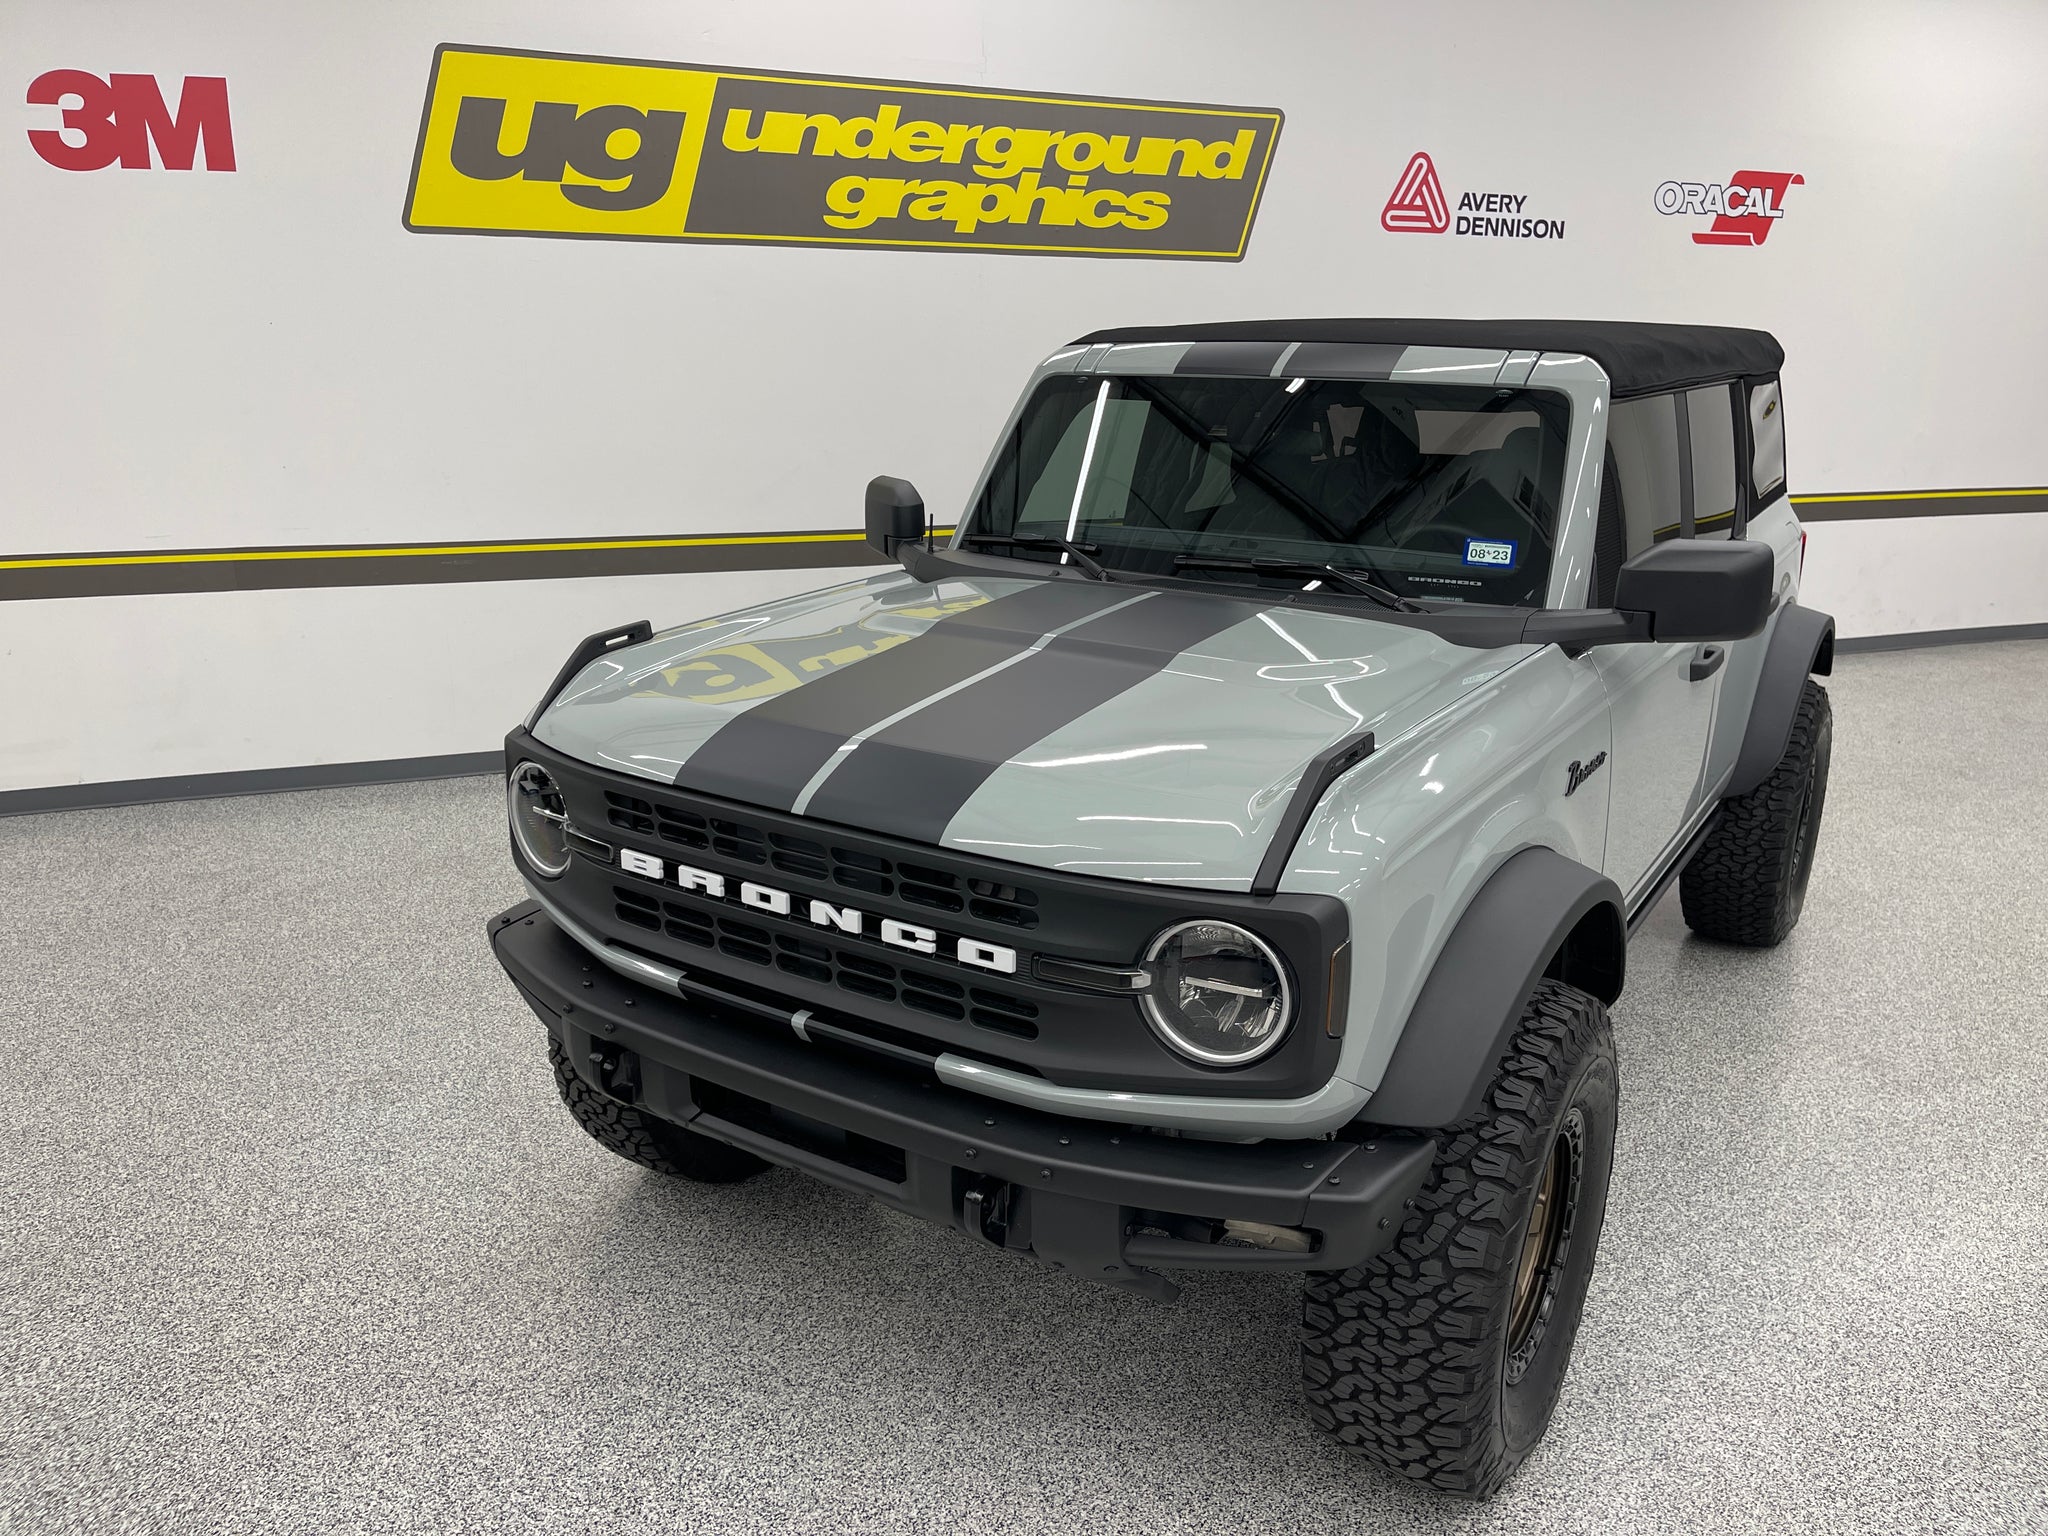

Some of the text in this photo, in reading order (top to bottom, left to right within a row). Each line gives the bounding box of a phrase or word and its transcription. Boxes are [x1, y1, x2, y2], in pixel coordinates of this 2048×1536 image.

[26, 69, 237, 172] 3M
[721, 104, 1257, 179] underground
[450, 96, 687, 212] ug
[823, 172, 1172, 234] graphics
[1455, 216, 1567, 239] DENNISON
[1457, 192, 1528, 214] AVERY
[1653, 180, 1784, 219] ORACAL
[1470, 548, 1508, 561] 08 23
[620, 848, 1017, 974] BRONCO
